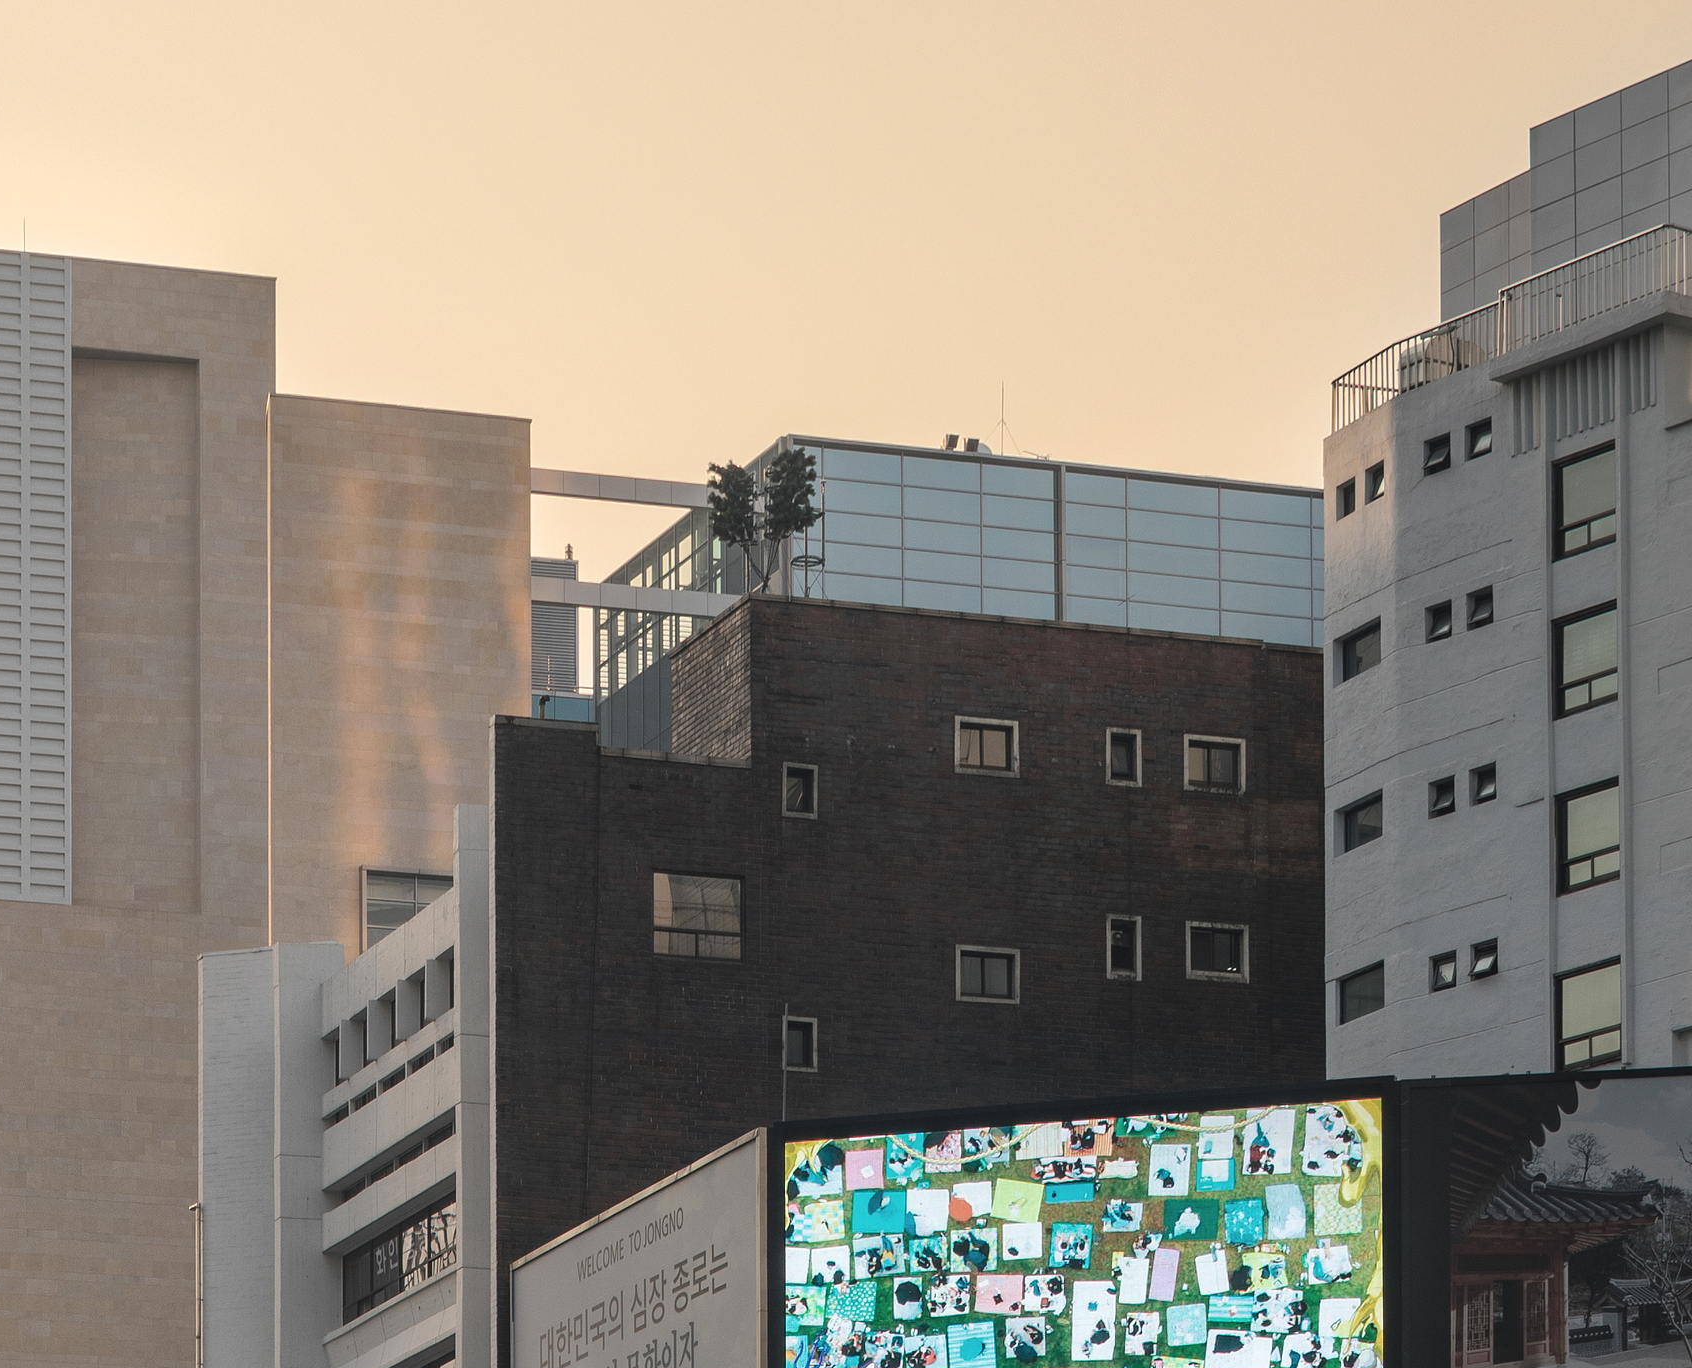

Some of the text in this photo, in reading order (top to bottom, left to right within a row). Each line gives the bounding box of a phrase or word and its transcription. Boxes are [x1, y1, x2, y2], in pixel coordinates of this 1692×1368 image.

[576, 1207, 685, 1283] WELCOME TO JONGNO
[630, 1268, 668, 1334] 심장
[671, 1243, 730, 1314] 종로는
